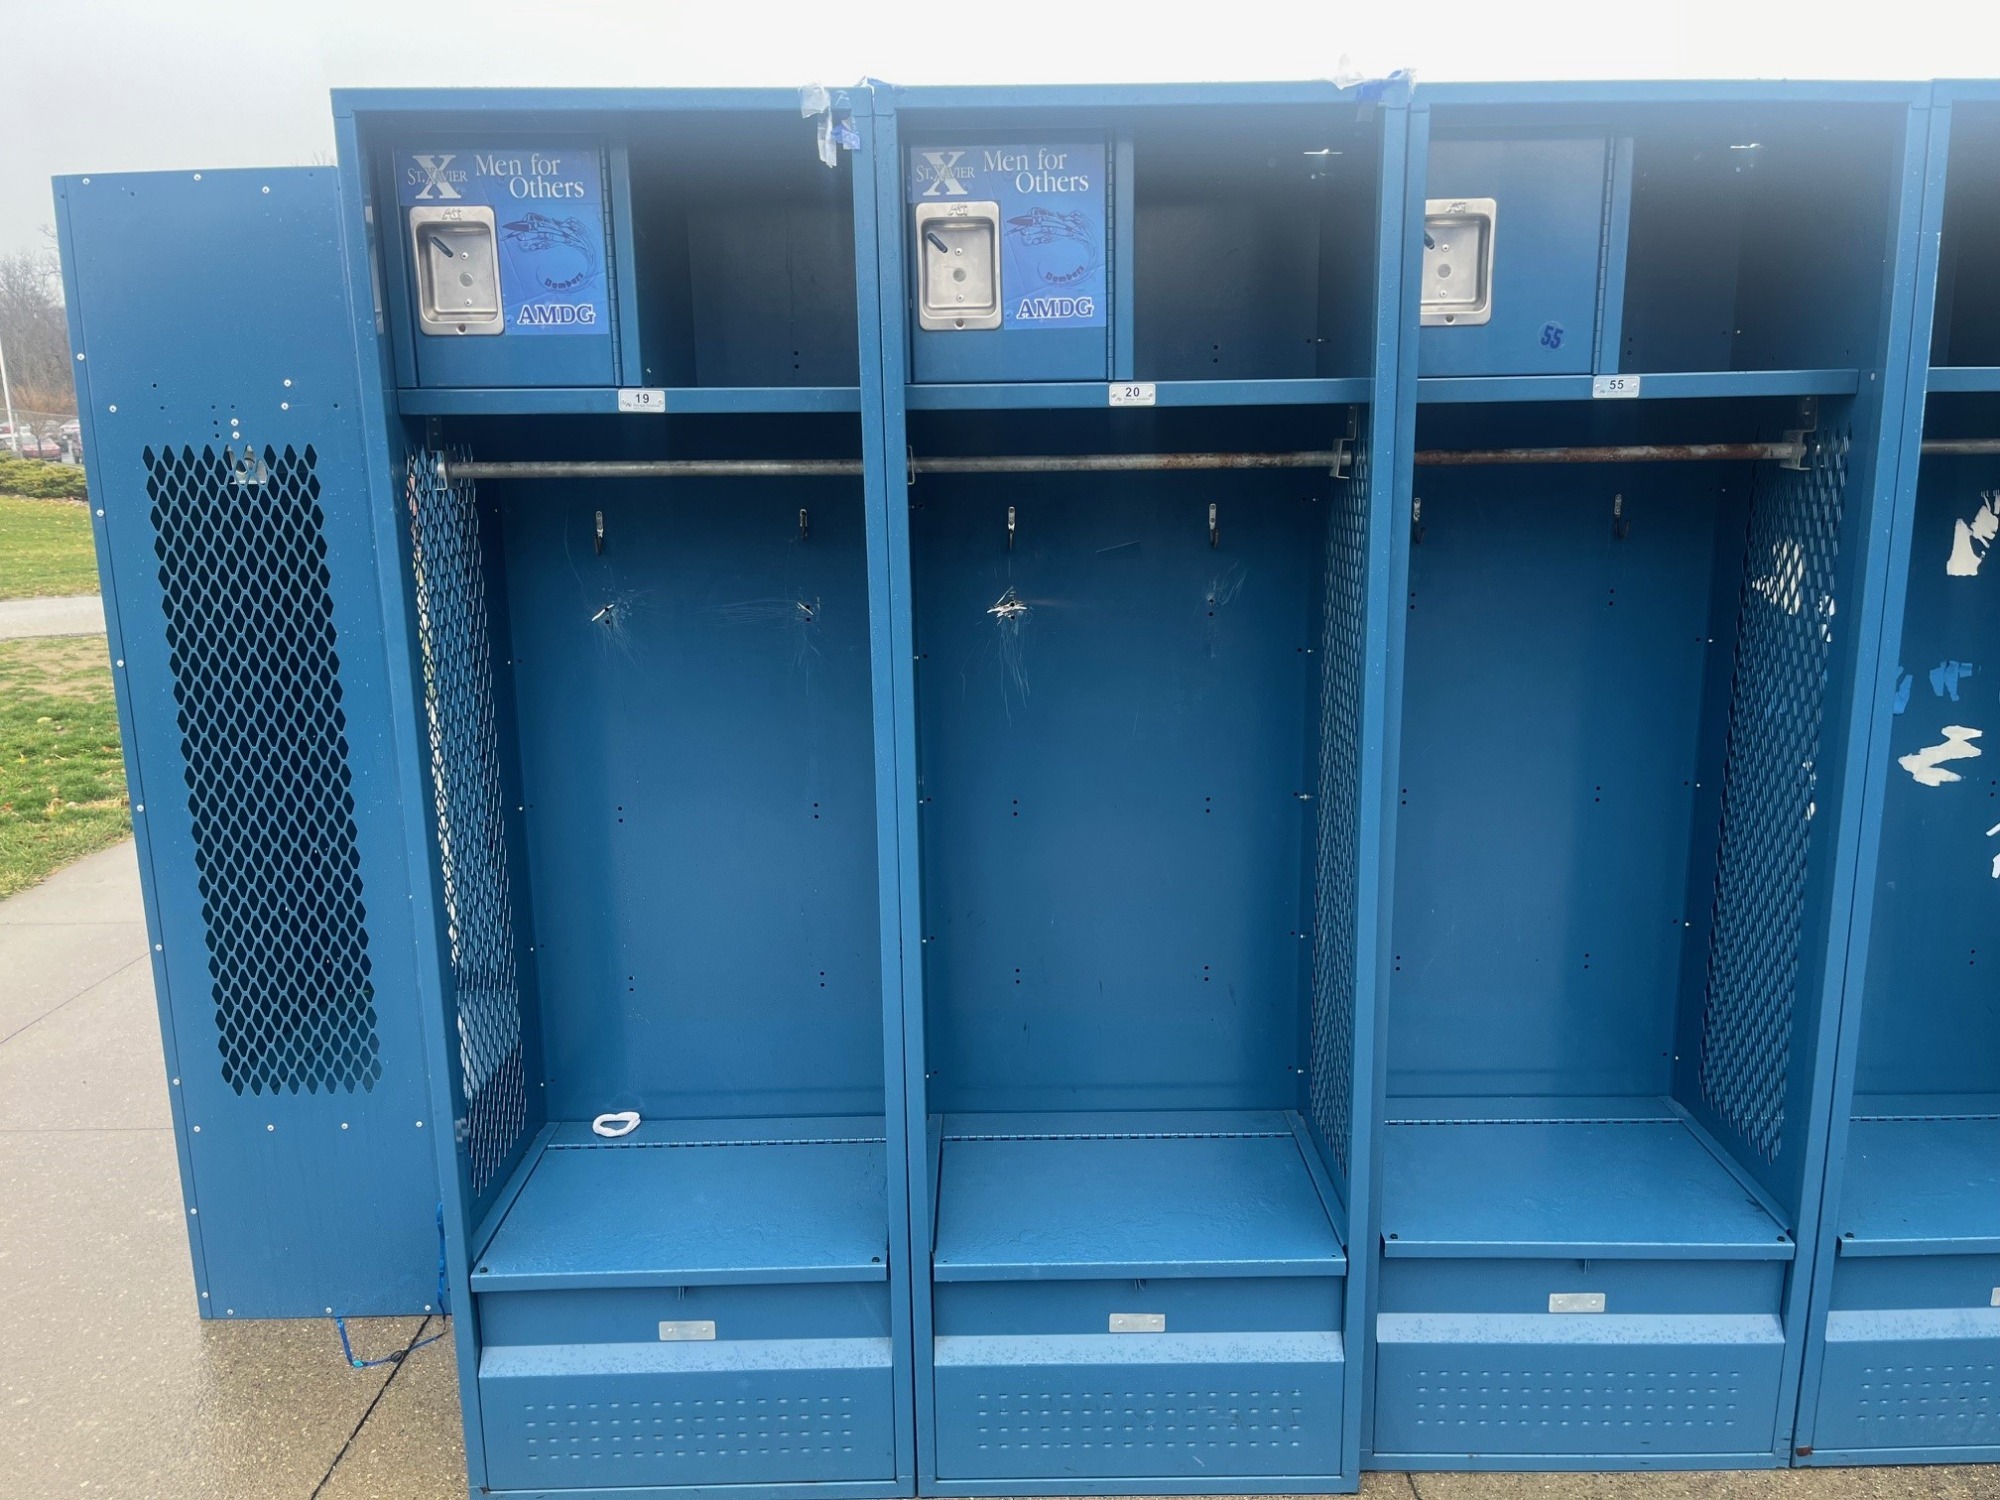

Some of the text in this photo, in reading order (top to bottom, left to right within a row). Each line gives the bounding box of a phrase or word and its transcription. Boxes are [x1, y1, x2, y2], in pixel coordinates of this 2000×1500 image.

[474, 153, 560, 176] Men for
[984, 148, 1067, 172] Men for
[509, 176, 584, 198] Others
[1015, 171, 1089, 194] Others
[517, 304, 596, 325] AMDG
[1017, 297, 1094, 320] AMDG
[1540, 325, 1564, 349] 55
[1125, 386, 1140, 398] 20
[1609, 379, 1624, 390] 55
[635, 393, 650, 404] 19
